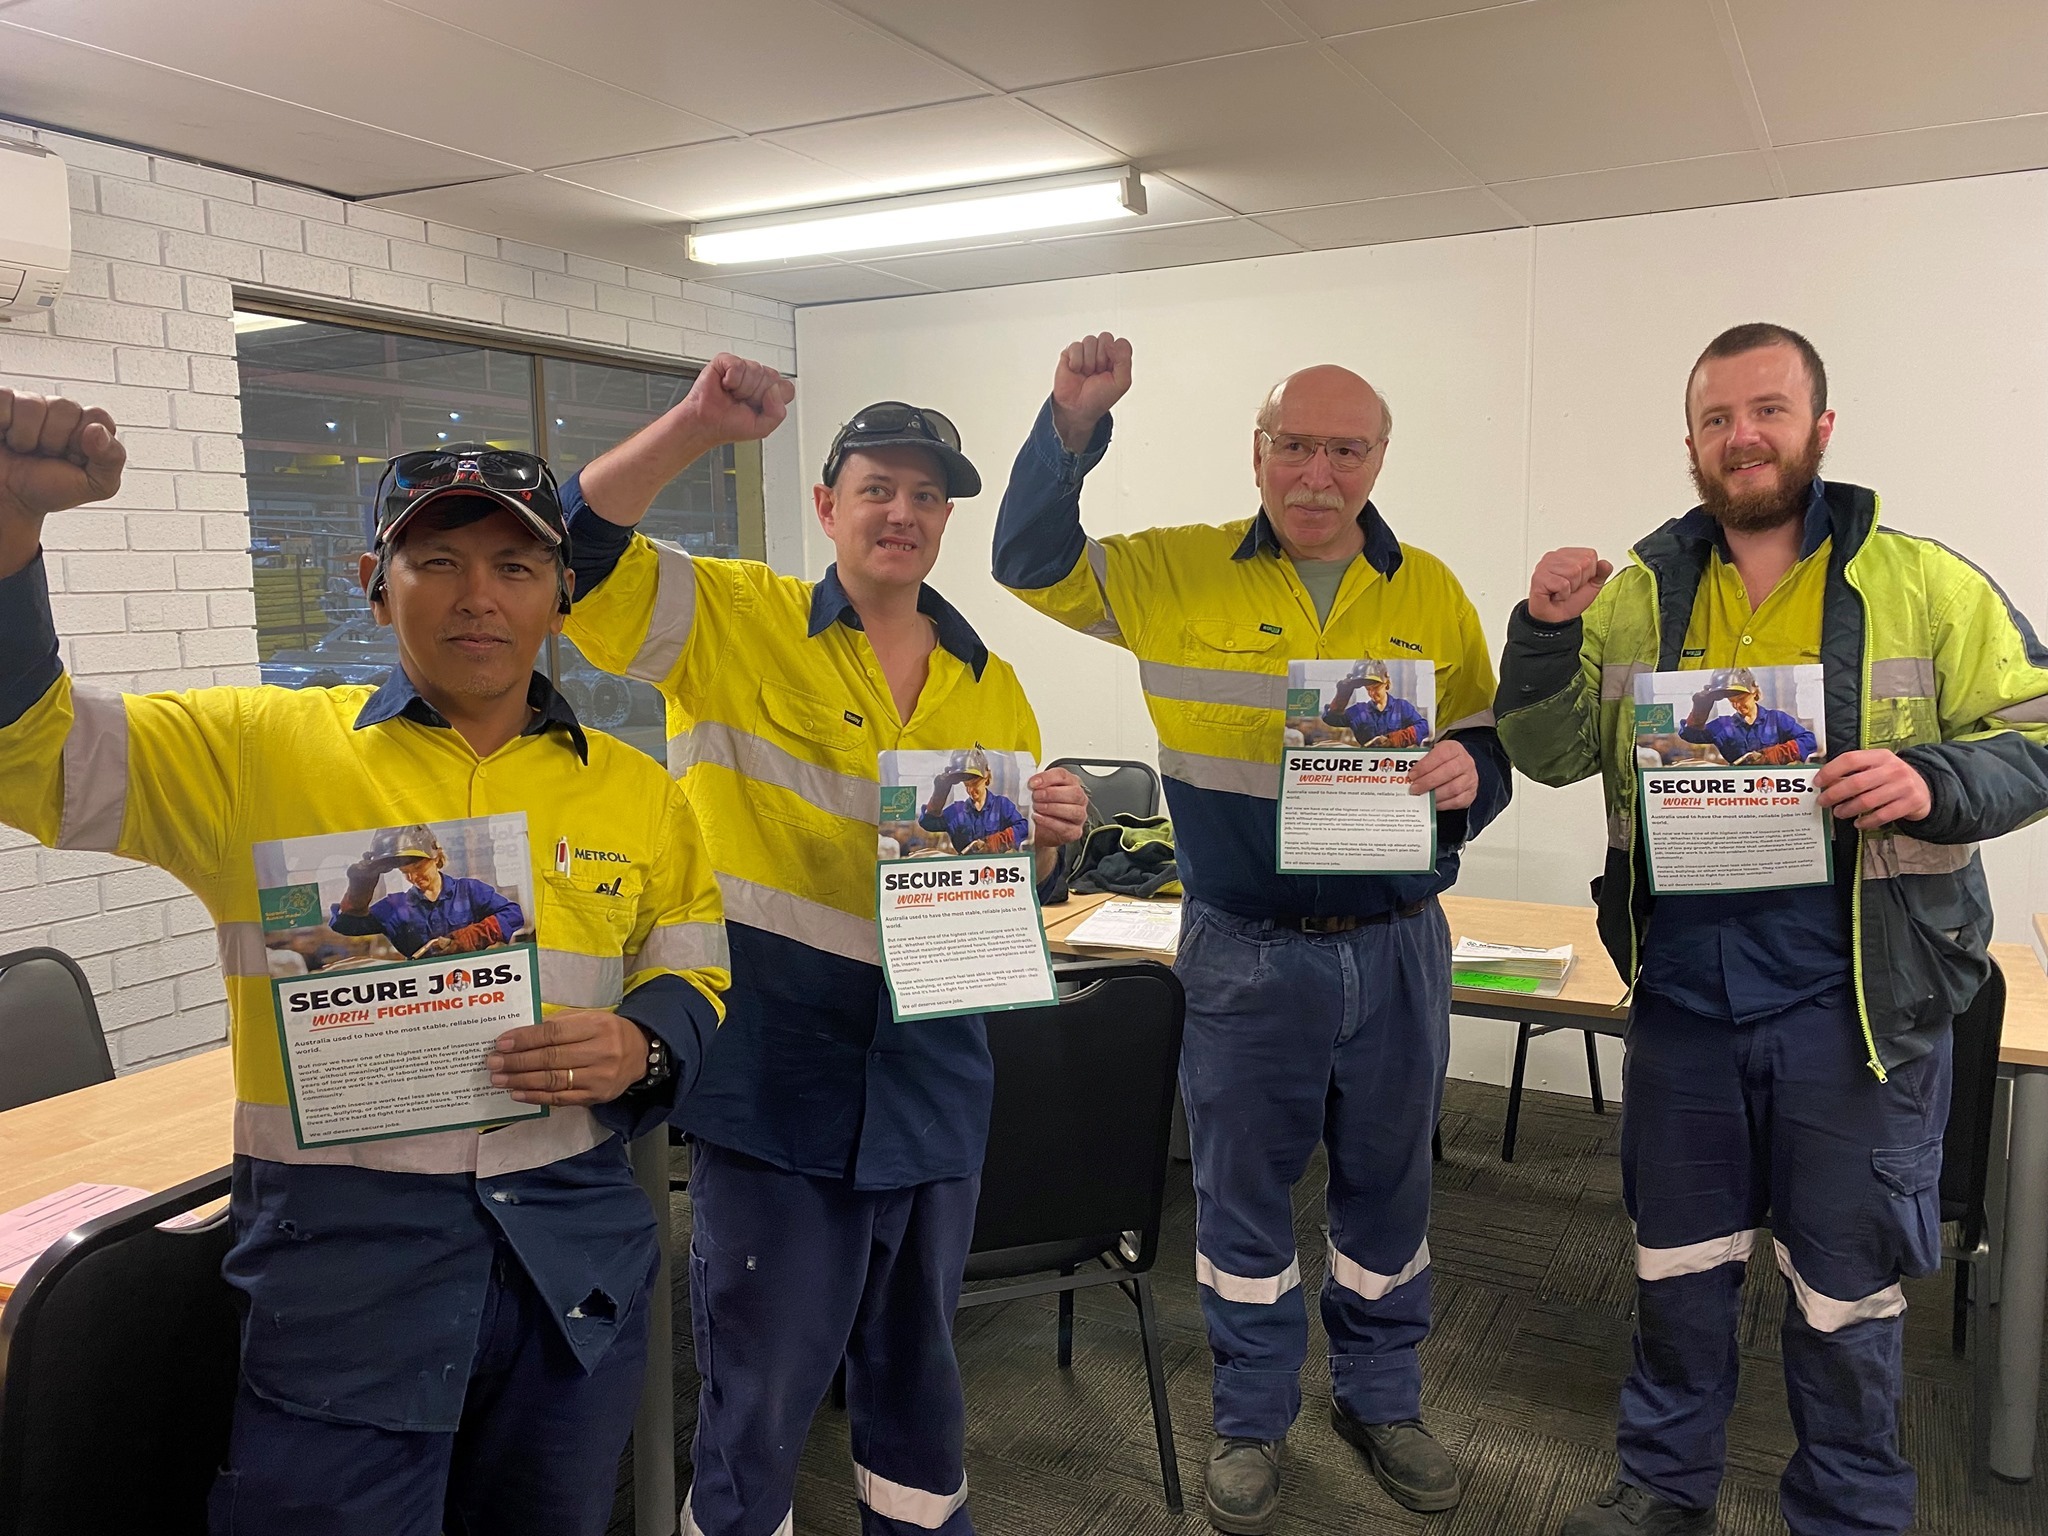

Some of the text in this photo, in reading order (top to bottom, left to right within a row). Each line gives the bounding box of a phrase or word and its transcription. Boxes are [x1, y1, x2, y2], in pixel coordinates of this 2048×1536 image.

[1389, 636, 1423, 654] METROLL
[1289, 758, 1363, 772] SECURE
[1299, 774, 1332, 782] WORTH
[1336, 775, 1387, 784] FIGHTING
[1649, 779, 1736, 794] SECURE
[1663, 797, 1800, 806] WORTH FIGHTING FOR
[574, 848, 631, 863] METROLL
[885, 870, 963, 891] SECURE
[897, 888, 1015, 905] WORTH FIGHTING FOR
[289, 978, 418, 1012] SECURE
[312, 991, 504, 1027] WORTH FIGHTING FOR
[294, 1038, 331, 1047] Australia
[450, 1019, 479, 1027] reliable
[295, 1047, 321, 1055] world.
